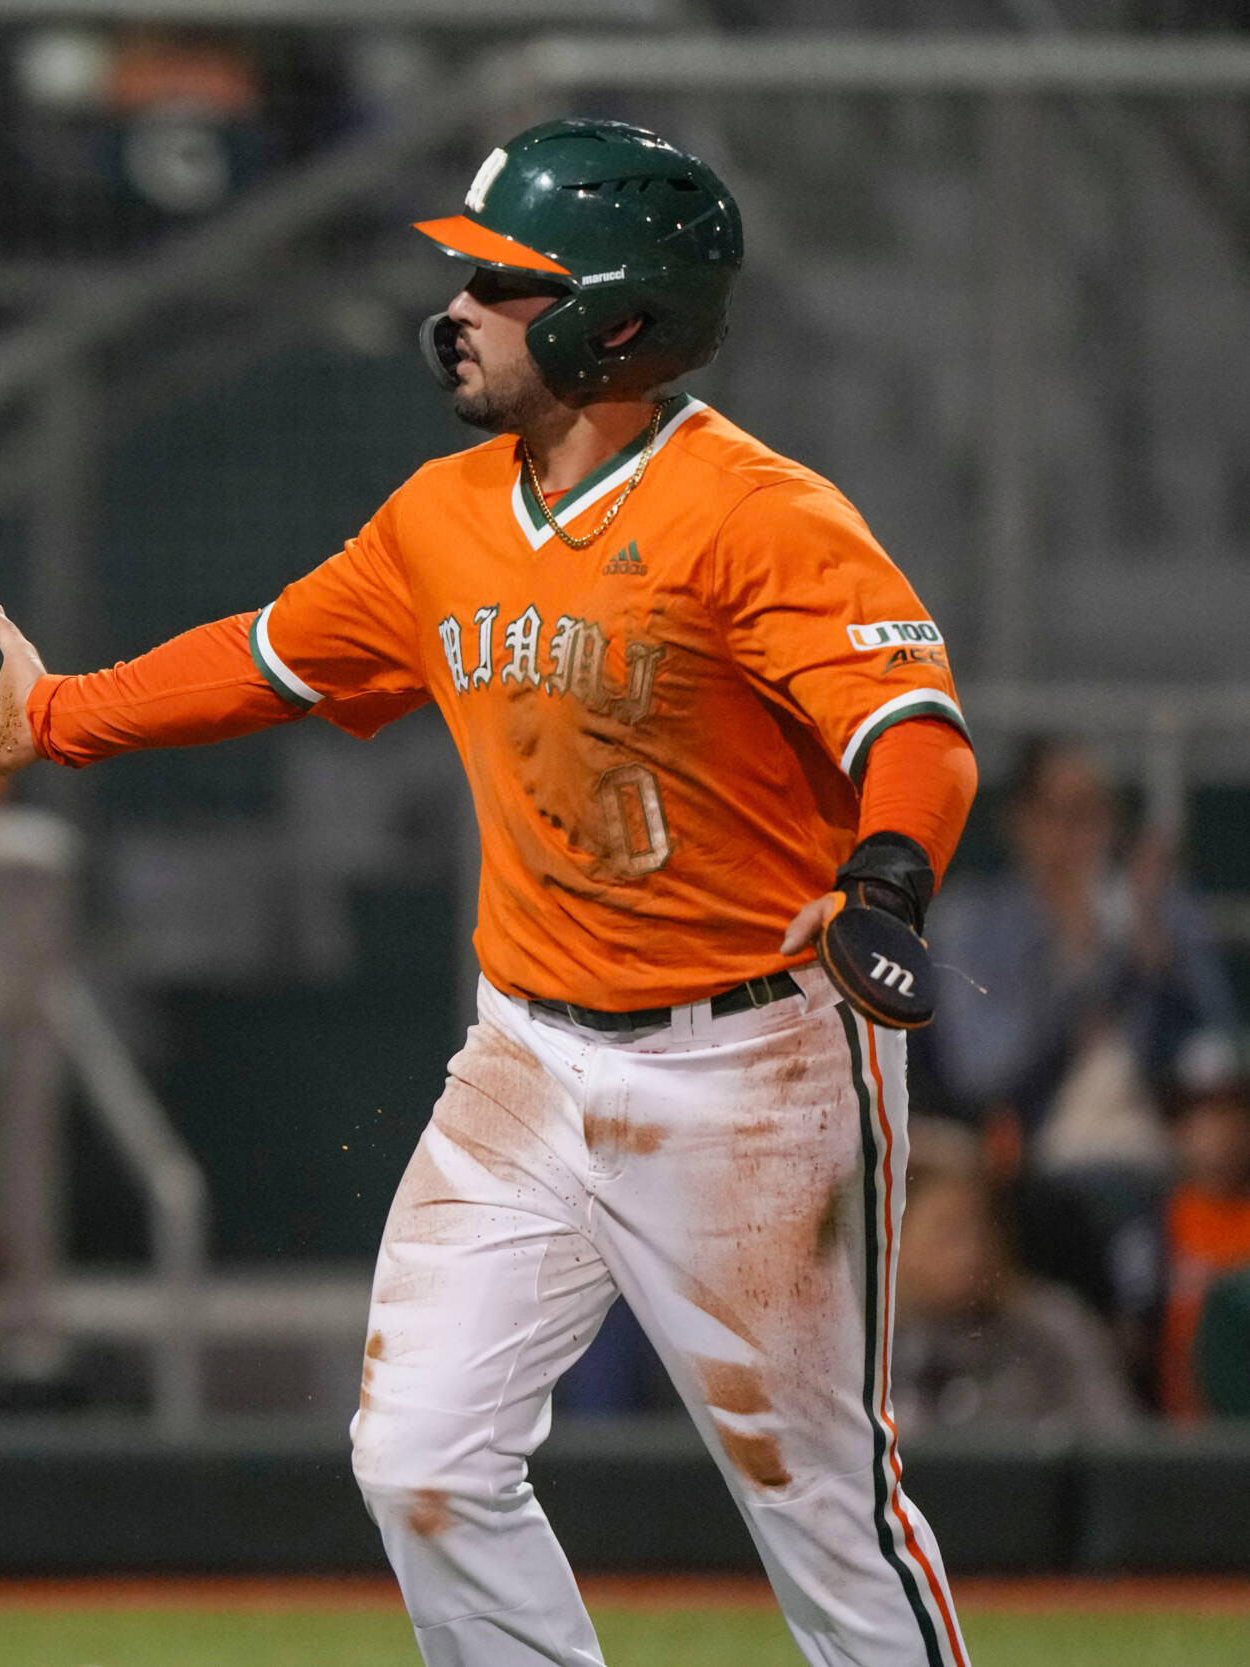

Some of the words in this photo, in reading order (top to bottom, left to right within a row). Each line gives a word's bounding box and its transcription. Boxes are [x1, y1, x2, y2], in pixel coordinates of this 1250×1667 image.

[581, 268, 625, 286] marucci
[602, 563, 648, 576] adidas
[892, 623, 939, 642] 100
[438, 602, 666, 725] MIAMI
[601, 763, 671, 875] 0
